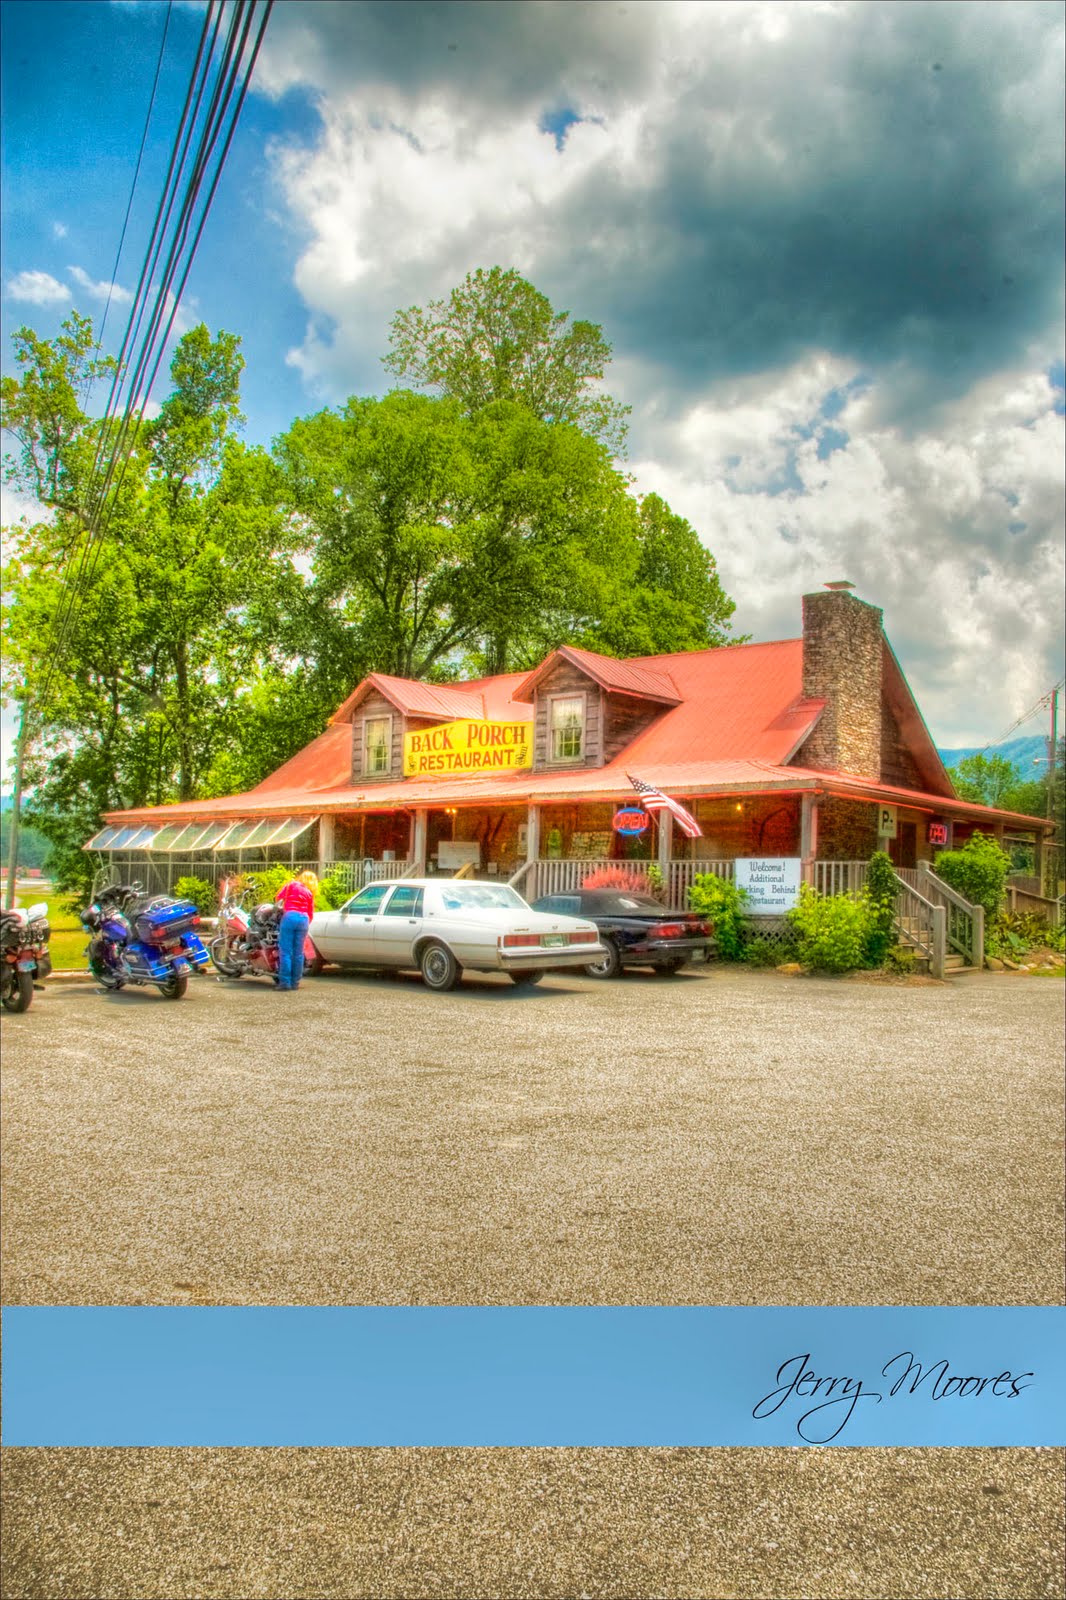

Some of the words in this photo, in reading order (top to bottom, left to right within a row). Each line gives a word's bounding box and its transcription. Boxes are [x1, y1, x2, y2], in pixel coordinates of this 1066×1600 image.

[411, 727, 453, 753] BACK
[467, 724, 526, 748] PORCH
[419, 749, 515, 772] RESTAURANT
[612, 812, 649, 829] OPEN
[749, 874, 785, 883] Additional
[738, 884, 765, 895] Prking
[771, 884, 796, 894] Behind
[749, 895, 786, 905] Restaurant
